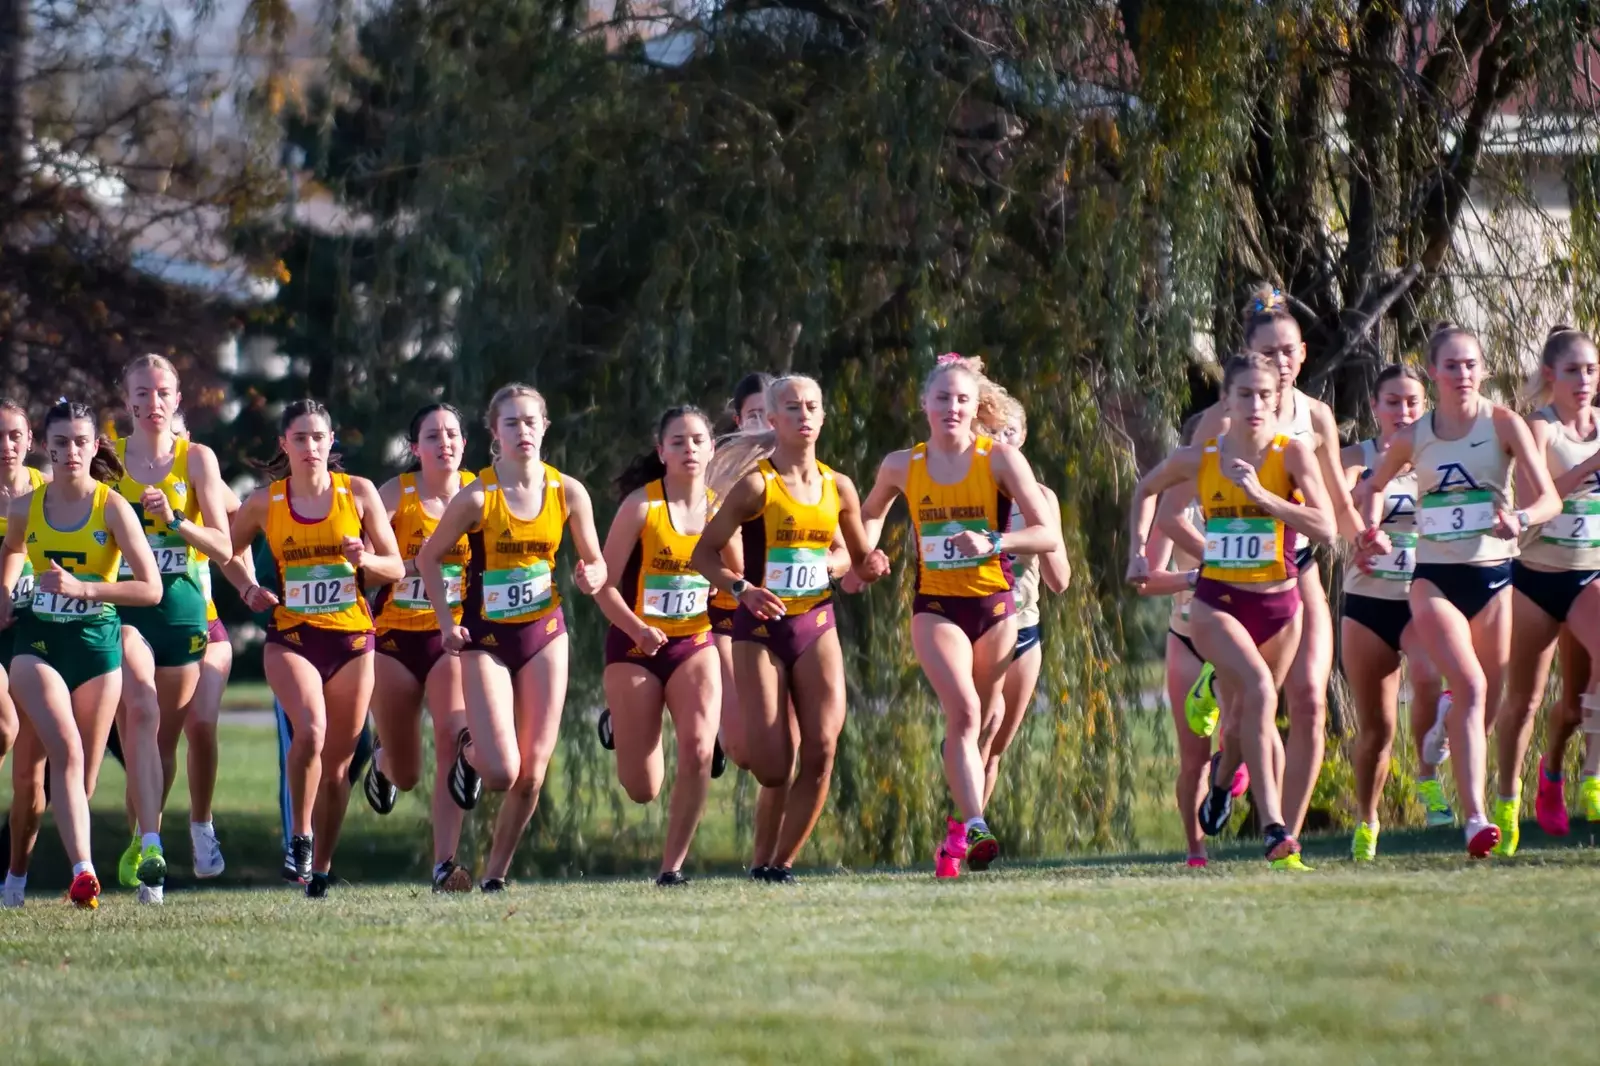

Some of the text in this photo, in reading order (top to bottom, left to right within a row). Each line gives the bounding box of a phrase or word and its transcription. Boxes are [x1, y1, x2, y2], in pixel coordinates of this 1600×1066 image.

[1452, 507, 1464, 530] 3
[1571, 517, 1585, 538] 2
[1220, 535, 1261, 559] 110
[175, 552, 187, 567] E
[1394, 550, 1408, 571] 4
[785, 565, 817, 588] 108
[34, 592, 46, 607] E
[302, 580, 342, 605] 102
[507, 582, 533, 608] 95
[662, 591, 696, 614] 113
